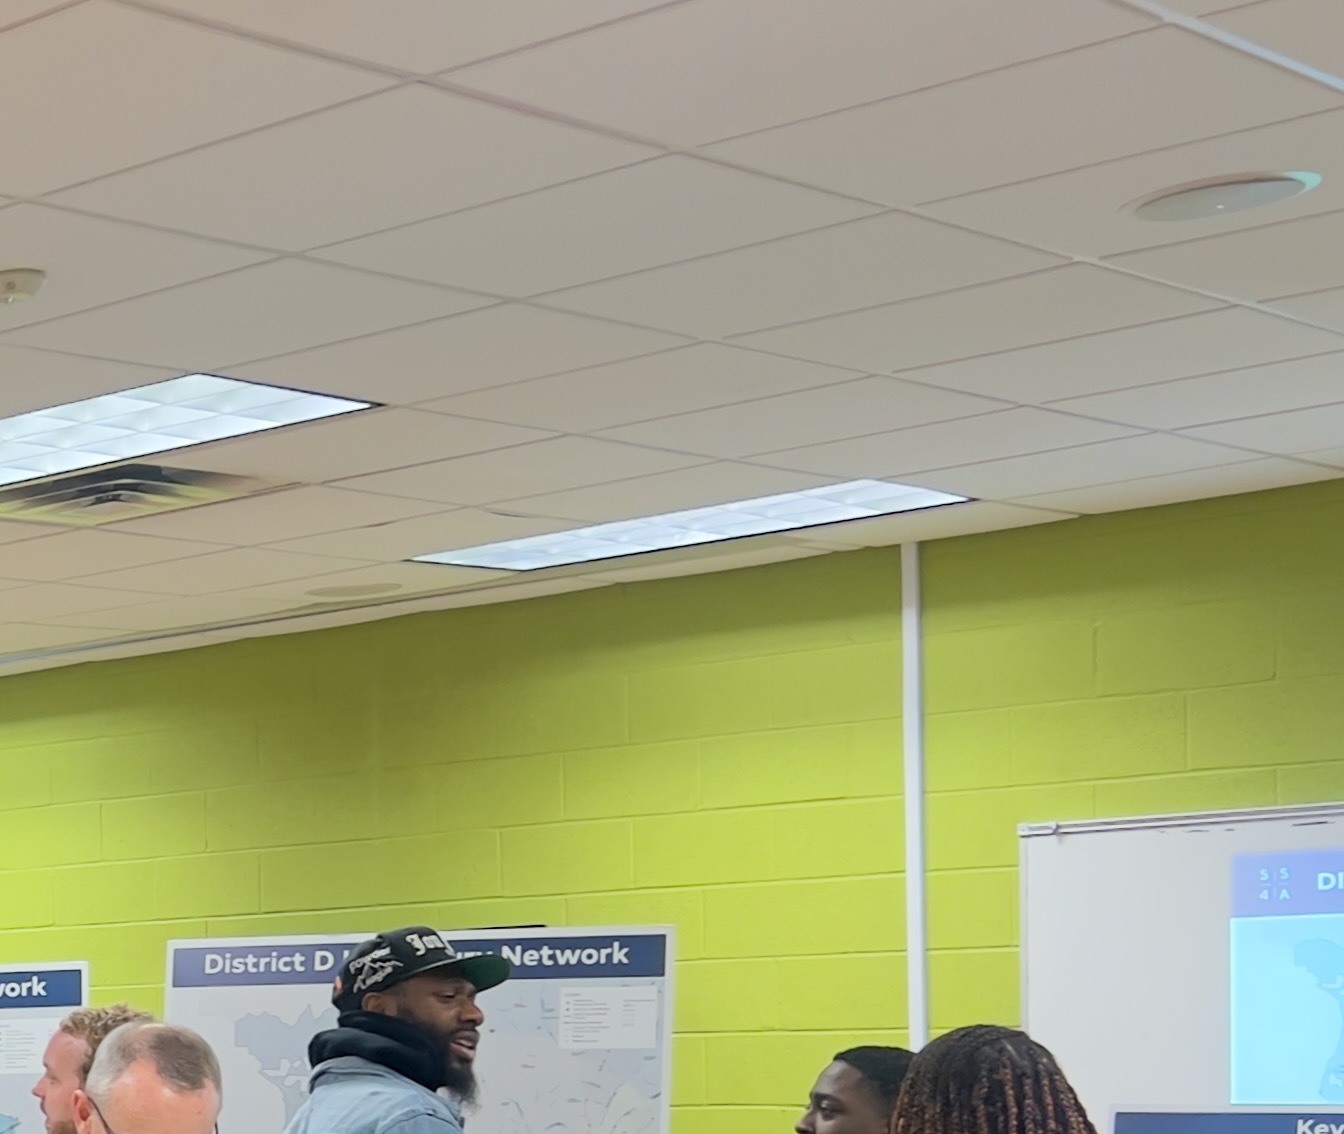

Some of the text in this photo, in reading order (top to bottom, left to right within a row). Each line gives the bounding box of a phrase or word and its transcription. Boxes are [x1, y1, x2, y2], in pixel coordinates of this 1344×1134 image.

[204, 951, 307, 975] District
[313, 951, 333, 972] D
[503, 941, 630, 967] Network
